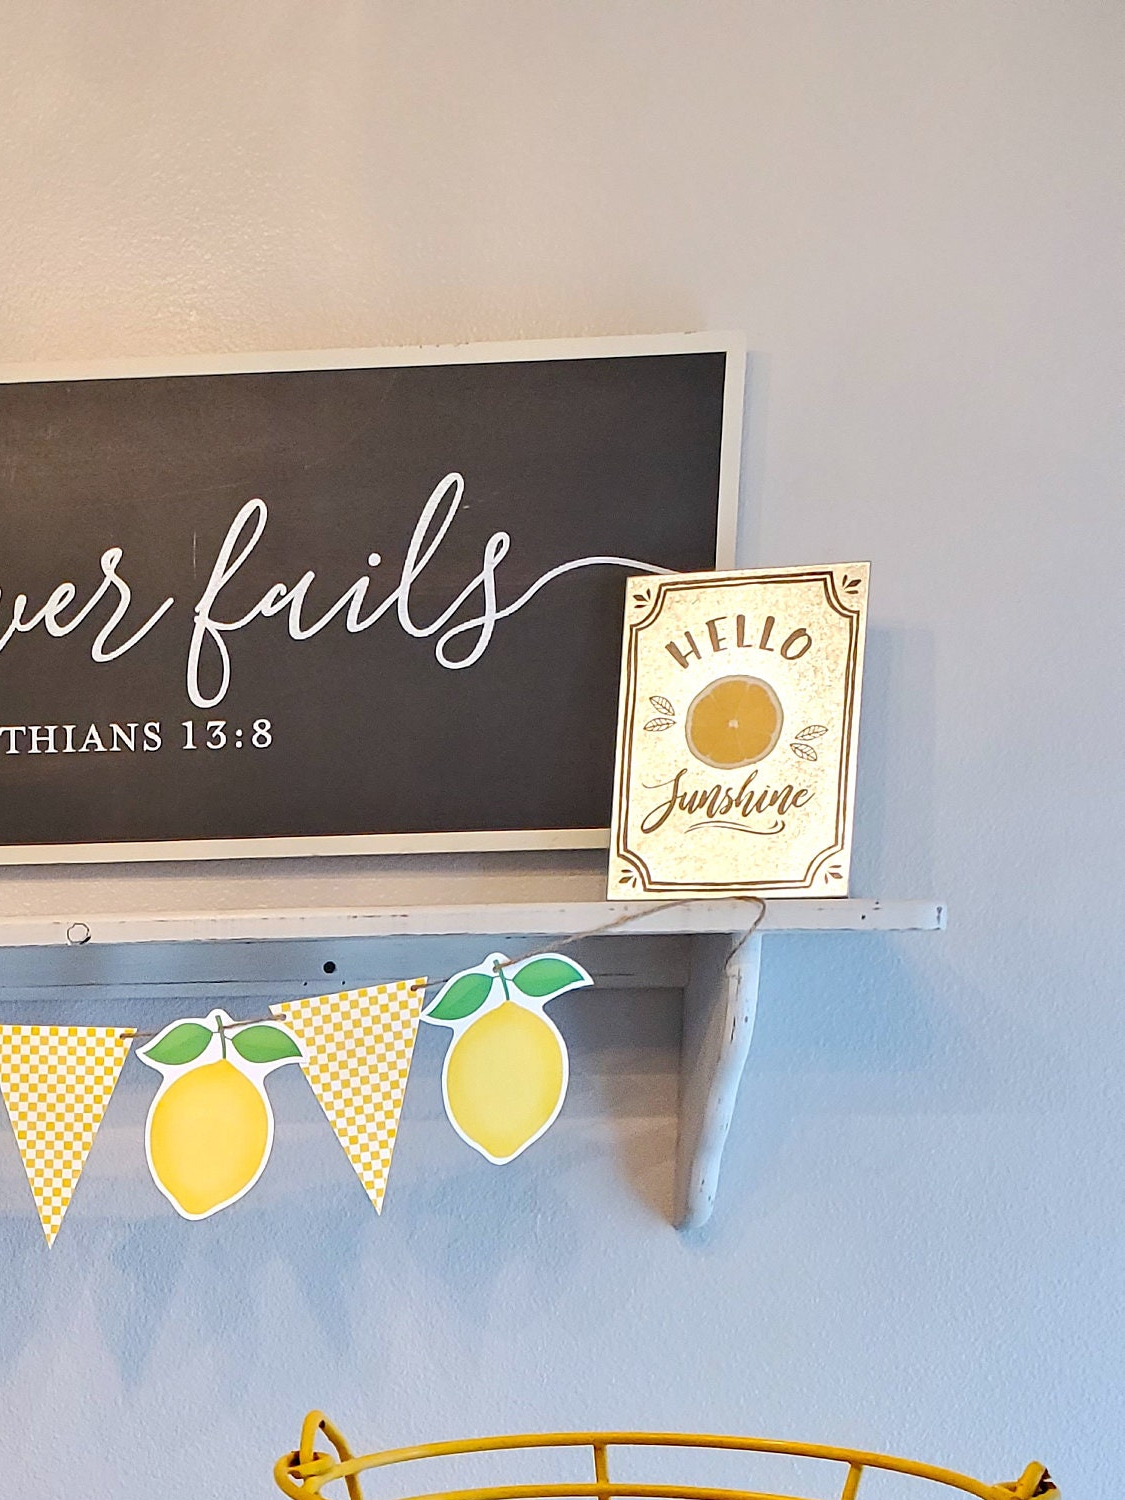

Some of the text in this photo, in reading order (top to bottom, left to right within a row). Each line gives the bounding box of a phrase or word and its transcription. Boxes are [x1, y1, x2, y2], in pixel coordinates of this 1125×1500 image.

[185, 472, 681, 709] fails
[665, 614, 813, 669] HELLO
[181, 717, 274, 752] 13:8
[641, 768, 815, 833] Sunshine
